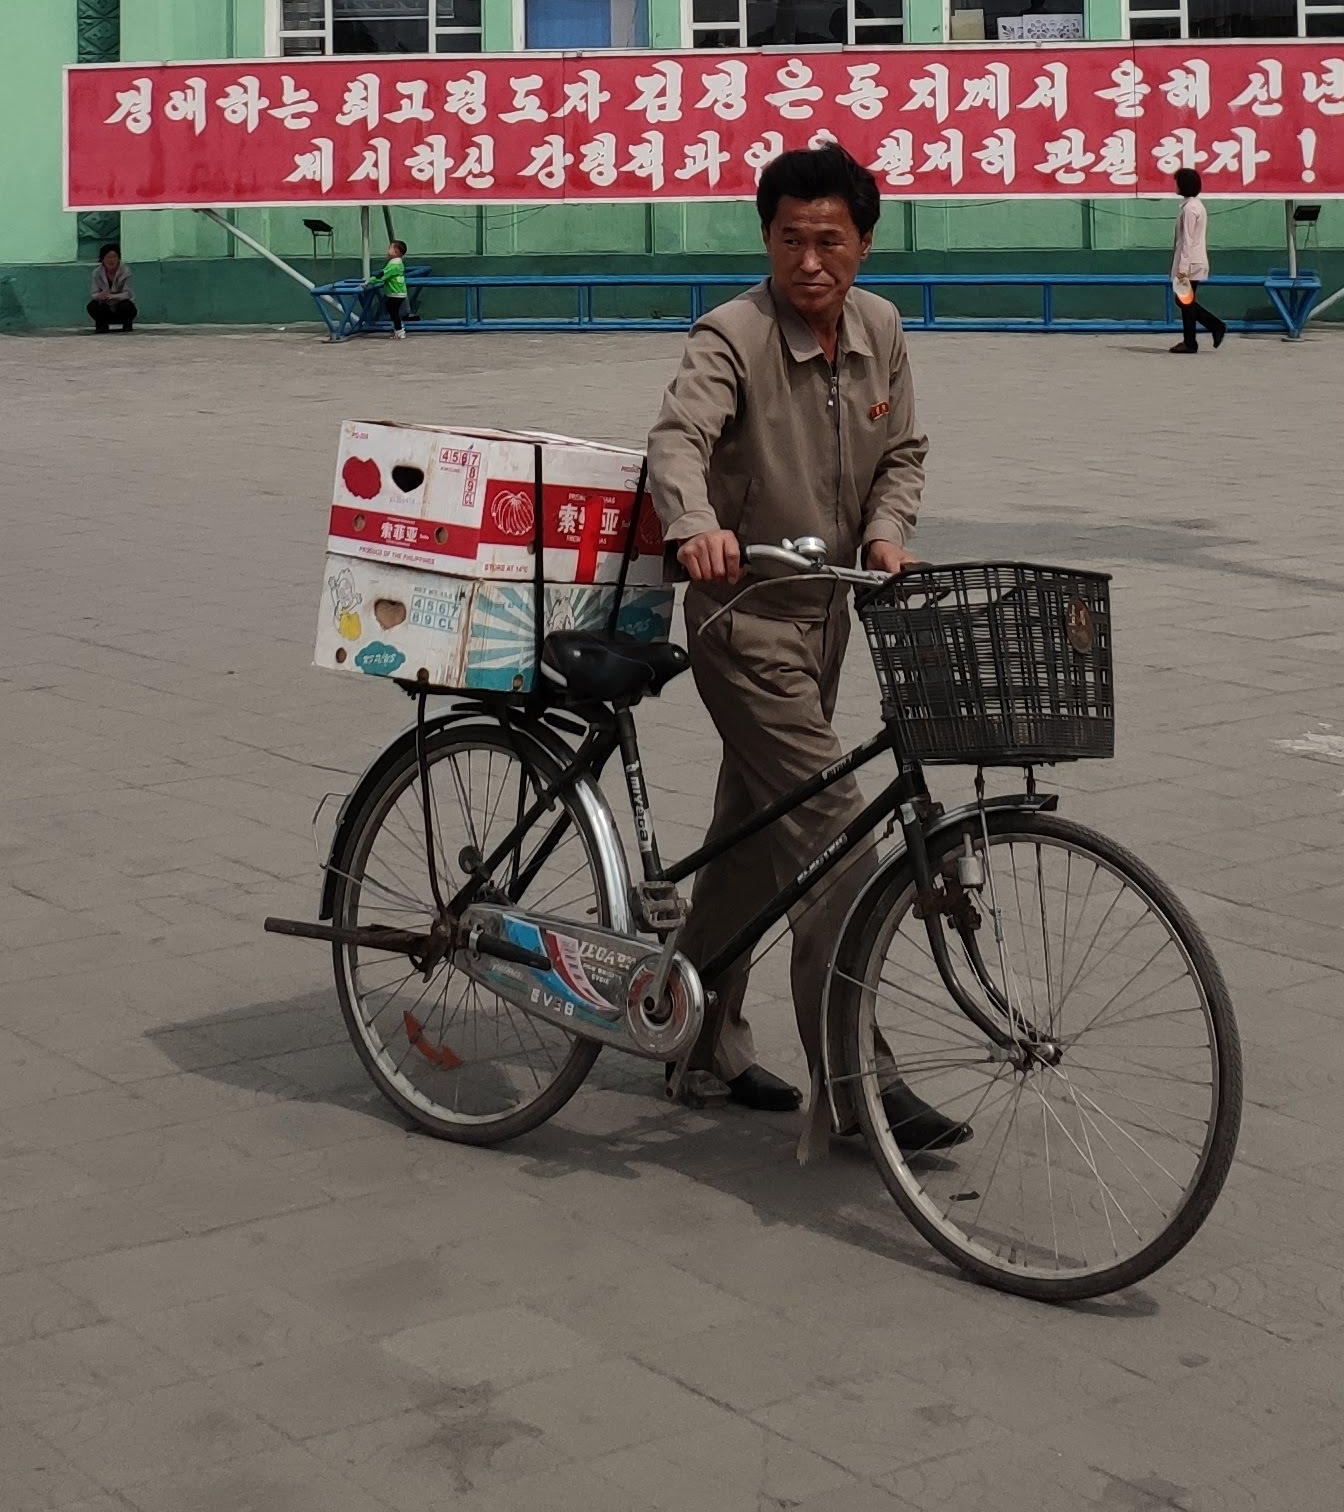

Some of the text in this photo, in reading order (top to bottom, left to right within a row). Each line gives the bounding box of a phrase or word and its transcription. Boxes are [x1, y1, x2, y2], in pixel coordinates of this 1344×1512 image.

[104, 75, 320, 136] 경애하는
[335, 69, 612, 132] 최고령도자
[1093, 58, 1212, 122] 올해
[282, 136, 495, 195] 제시하신
[866, 126, 1017, 186] 철저히
